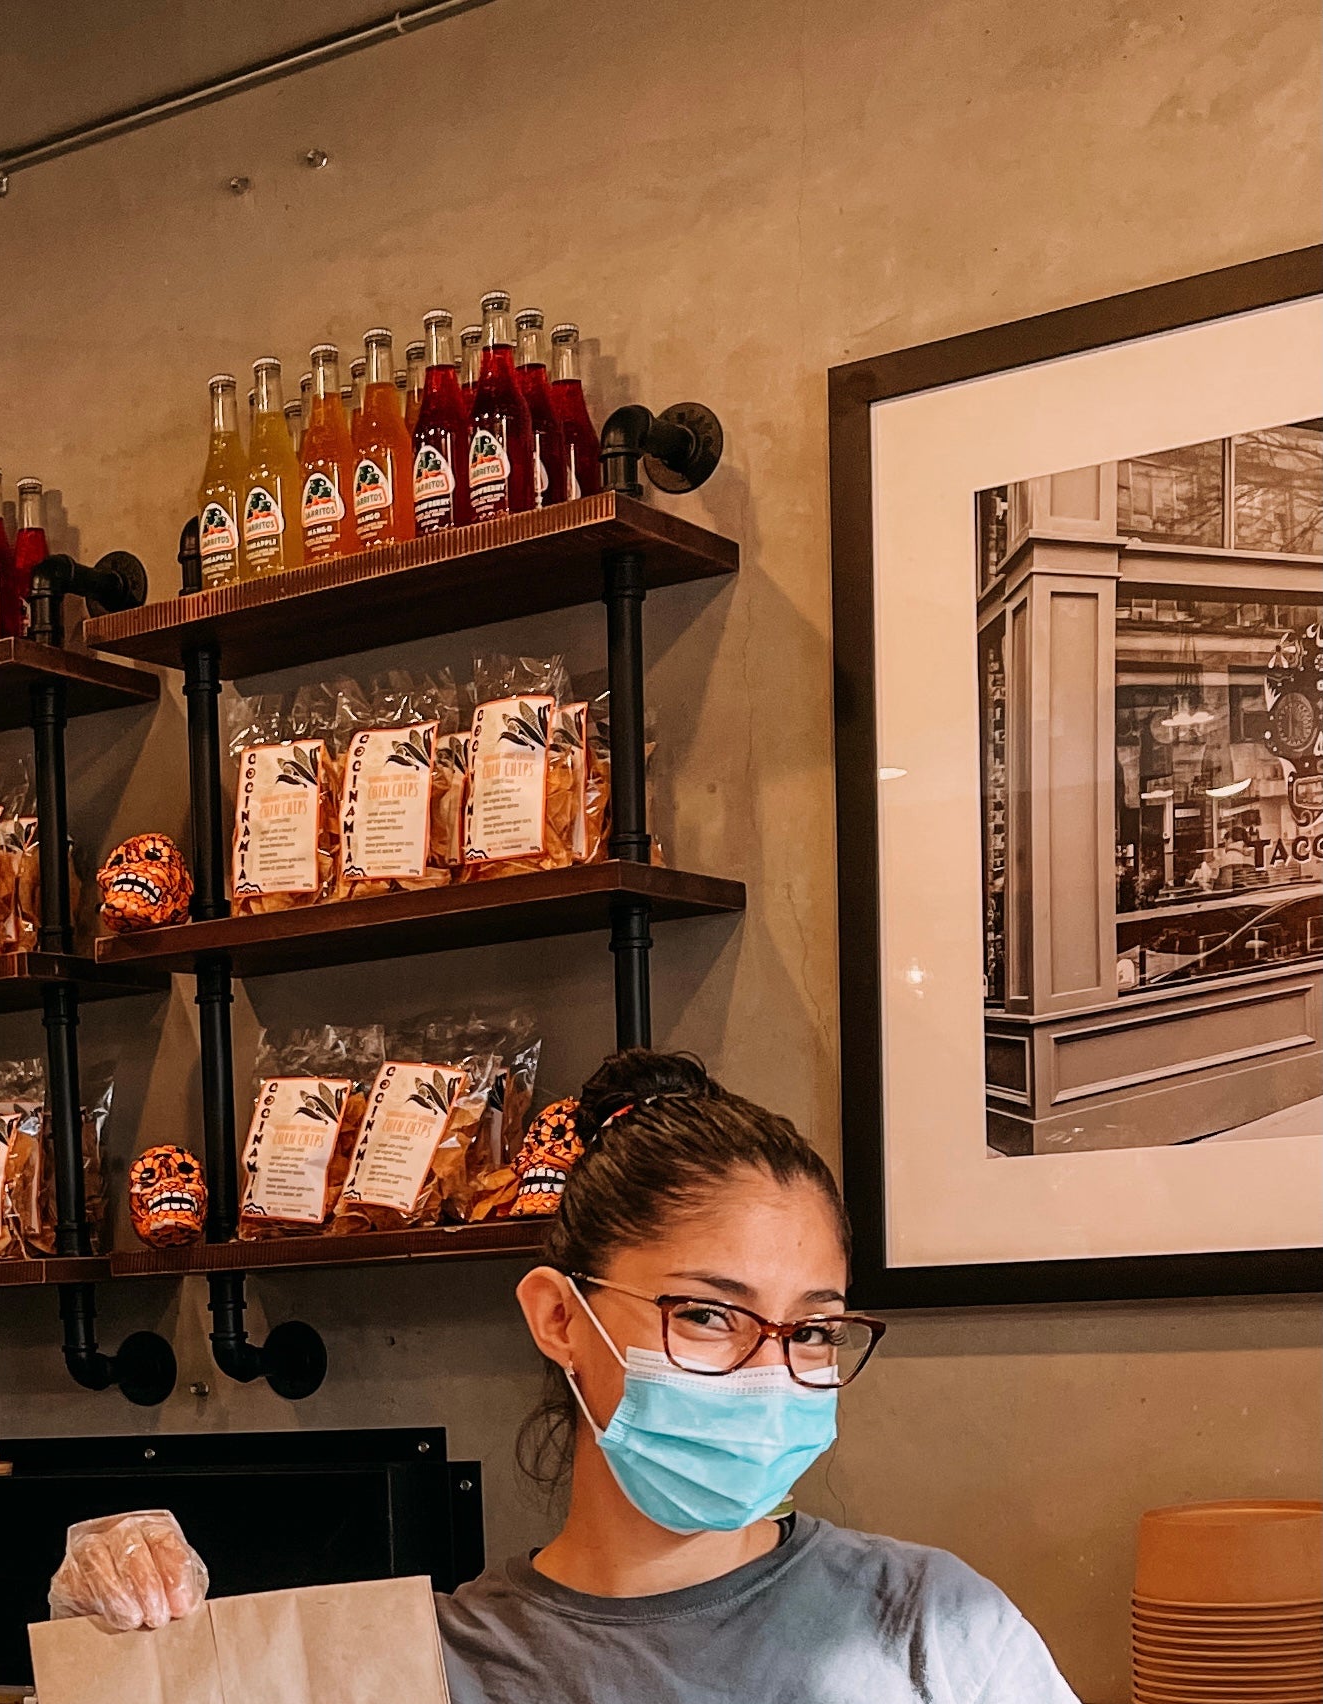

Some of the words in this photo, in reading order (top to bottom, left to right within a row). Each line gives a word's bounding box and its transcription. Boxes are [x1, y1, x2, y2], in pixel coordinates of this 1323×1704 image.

[238, 753, 257, 881] COCINAMIA
[343, 734, 371, 864] COCINAMIA
[347, 1066, 397, 1188] COCINAMIA
